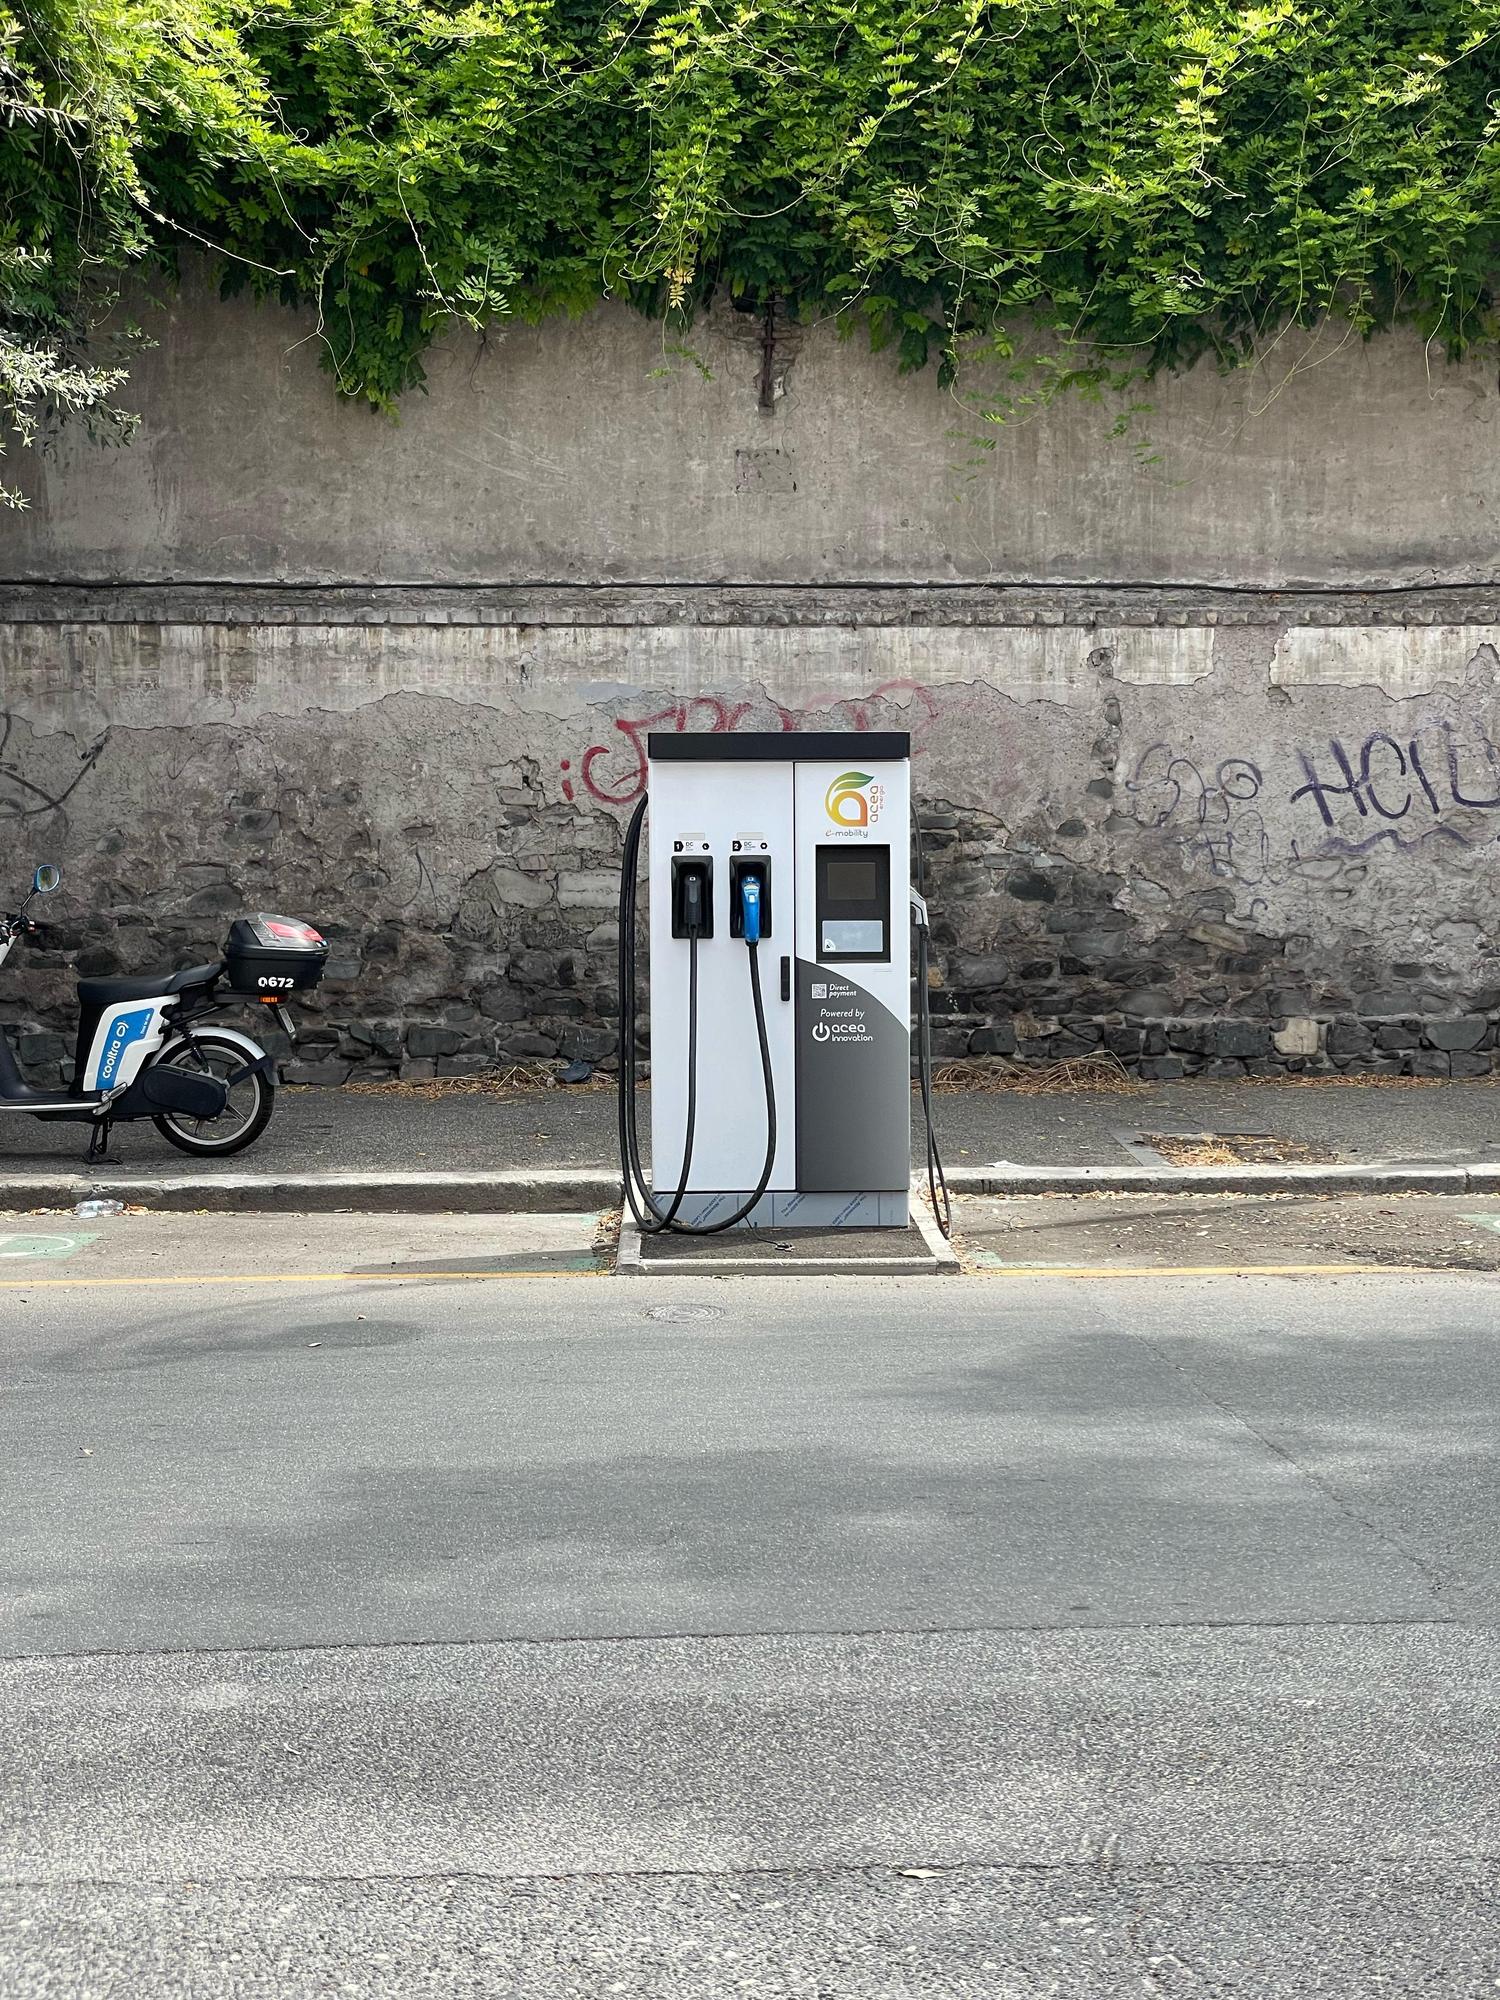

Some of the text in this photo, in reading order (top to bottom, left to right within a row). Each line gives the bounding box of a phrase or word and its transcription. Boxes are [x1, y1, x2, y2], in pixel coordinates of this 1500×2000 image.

[870, 785, 879, 823] acea
[820, 1008, 865, 1020] Powered by
[831, 1024, 866, 1033] acea
[102, 1040, 122, 1079] cooltra
